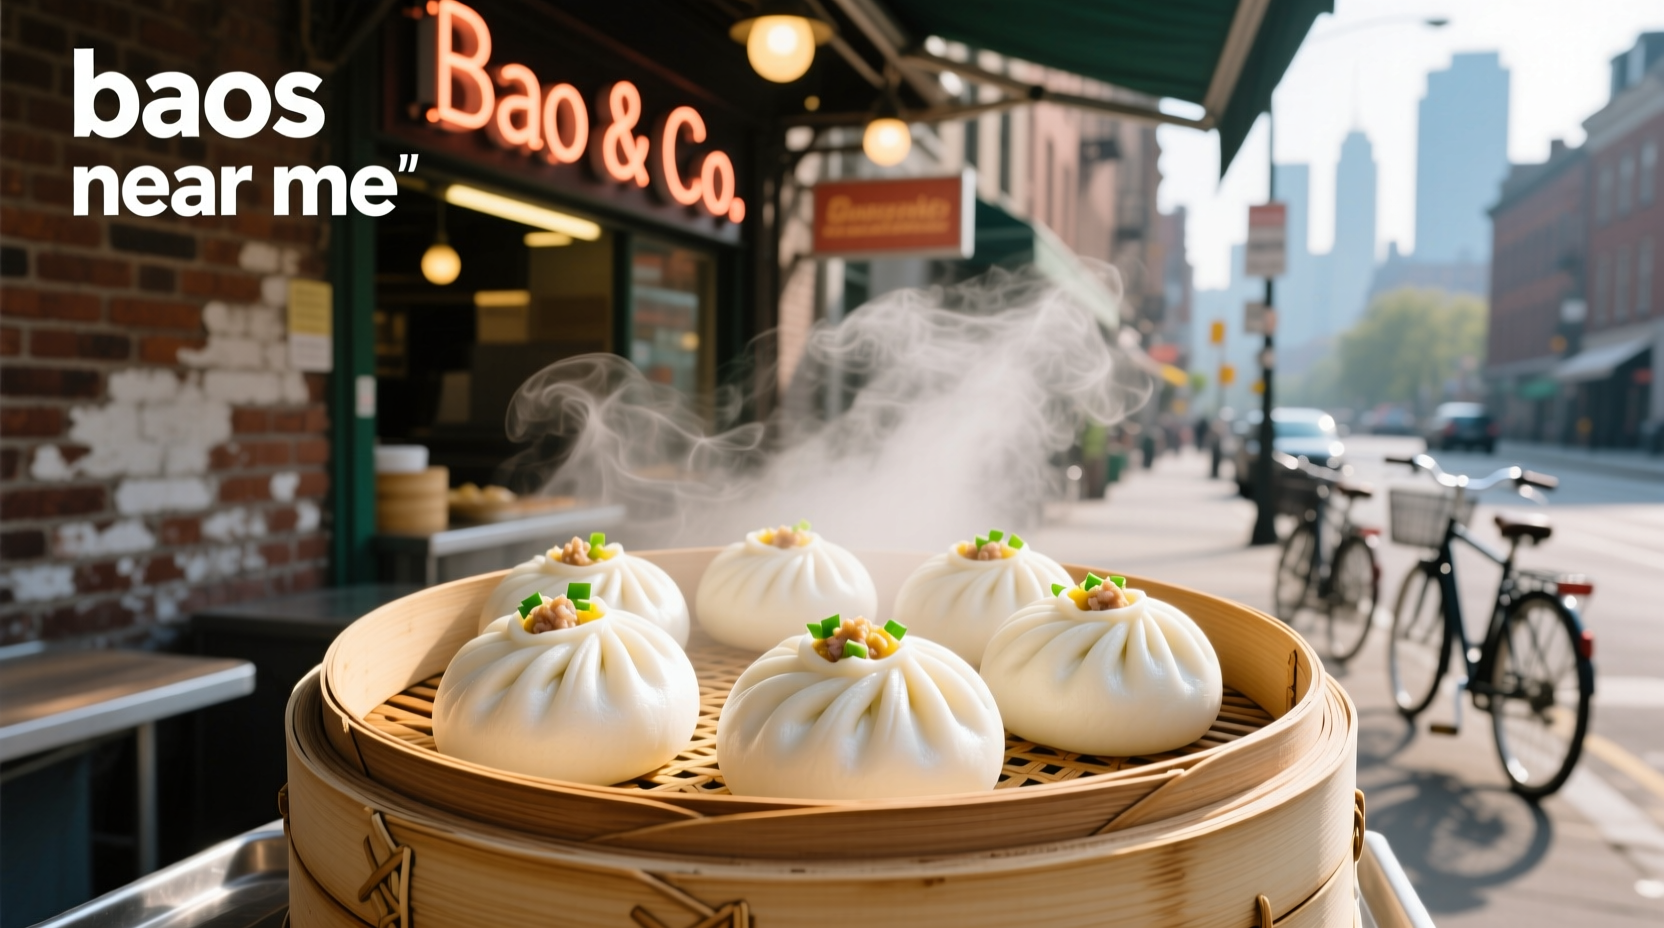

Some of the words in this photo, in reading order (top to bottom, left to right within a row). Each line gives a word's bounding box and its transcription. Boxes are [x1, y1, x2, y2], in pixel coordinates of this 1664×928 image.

[437, 0, 589, 164] Bao
[602, 80, 650, 188] &
[662, 106, 746, 223] Co.
